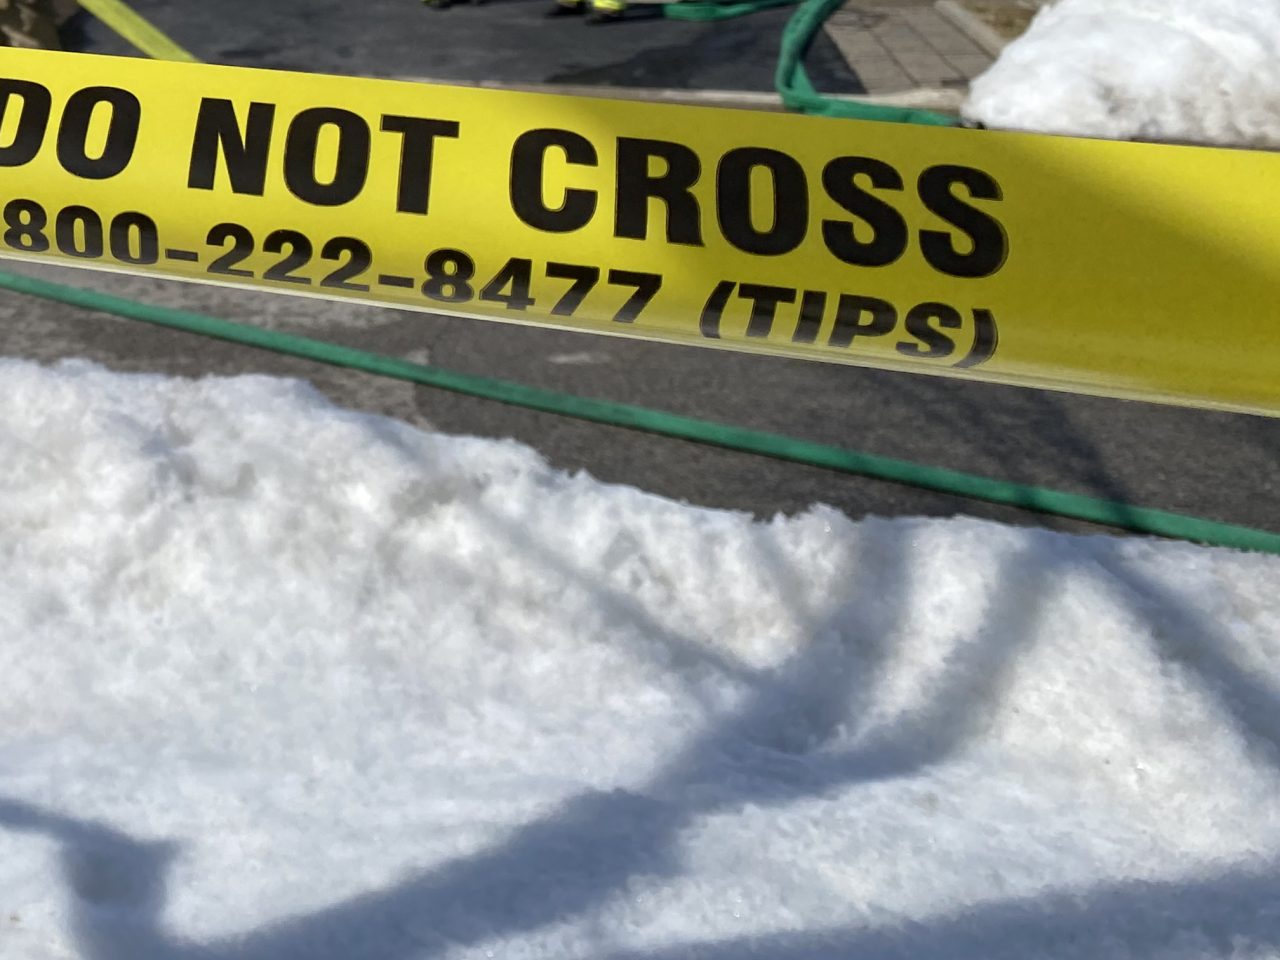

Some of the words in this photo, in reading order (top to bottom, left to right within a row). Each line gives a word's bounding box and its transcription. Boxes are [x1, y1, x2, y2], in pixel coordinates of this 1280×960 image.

[187, 97, 460, 215] NOT
[508, 128, 1010, 280] CROSS
[698, 280, 999, 368] (TIPS)
